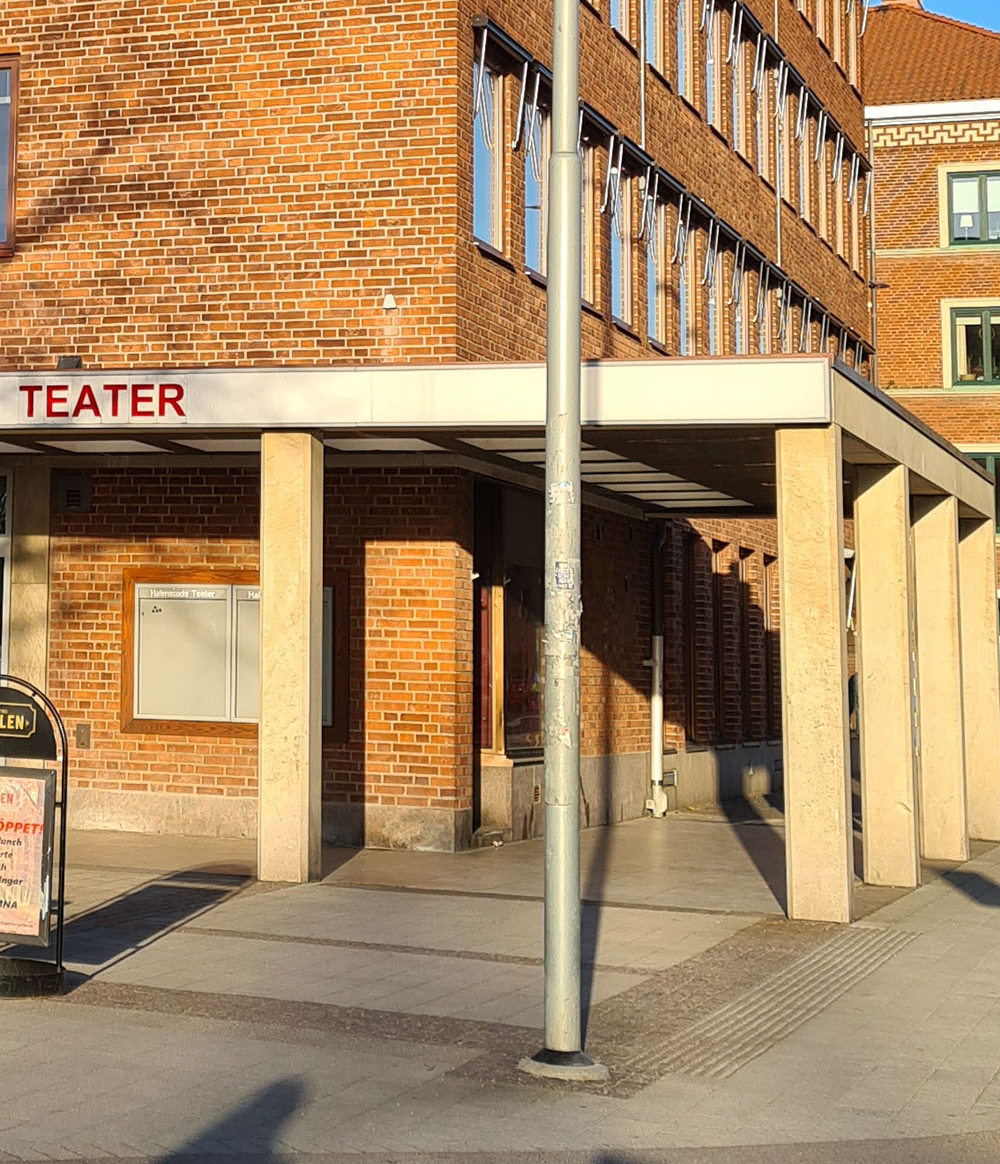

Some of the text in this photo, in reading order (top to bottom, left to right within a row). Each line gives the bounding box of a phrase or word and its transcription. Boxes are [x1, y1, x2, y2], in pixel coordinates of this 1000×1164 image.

[19, 383, 186, 418] TEATER
[149, 588, 216, 599] Halmstads Teater
